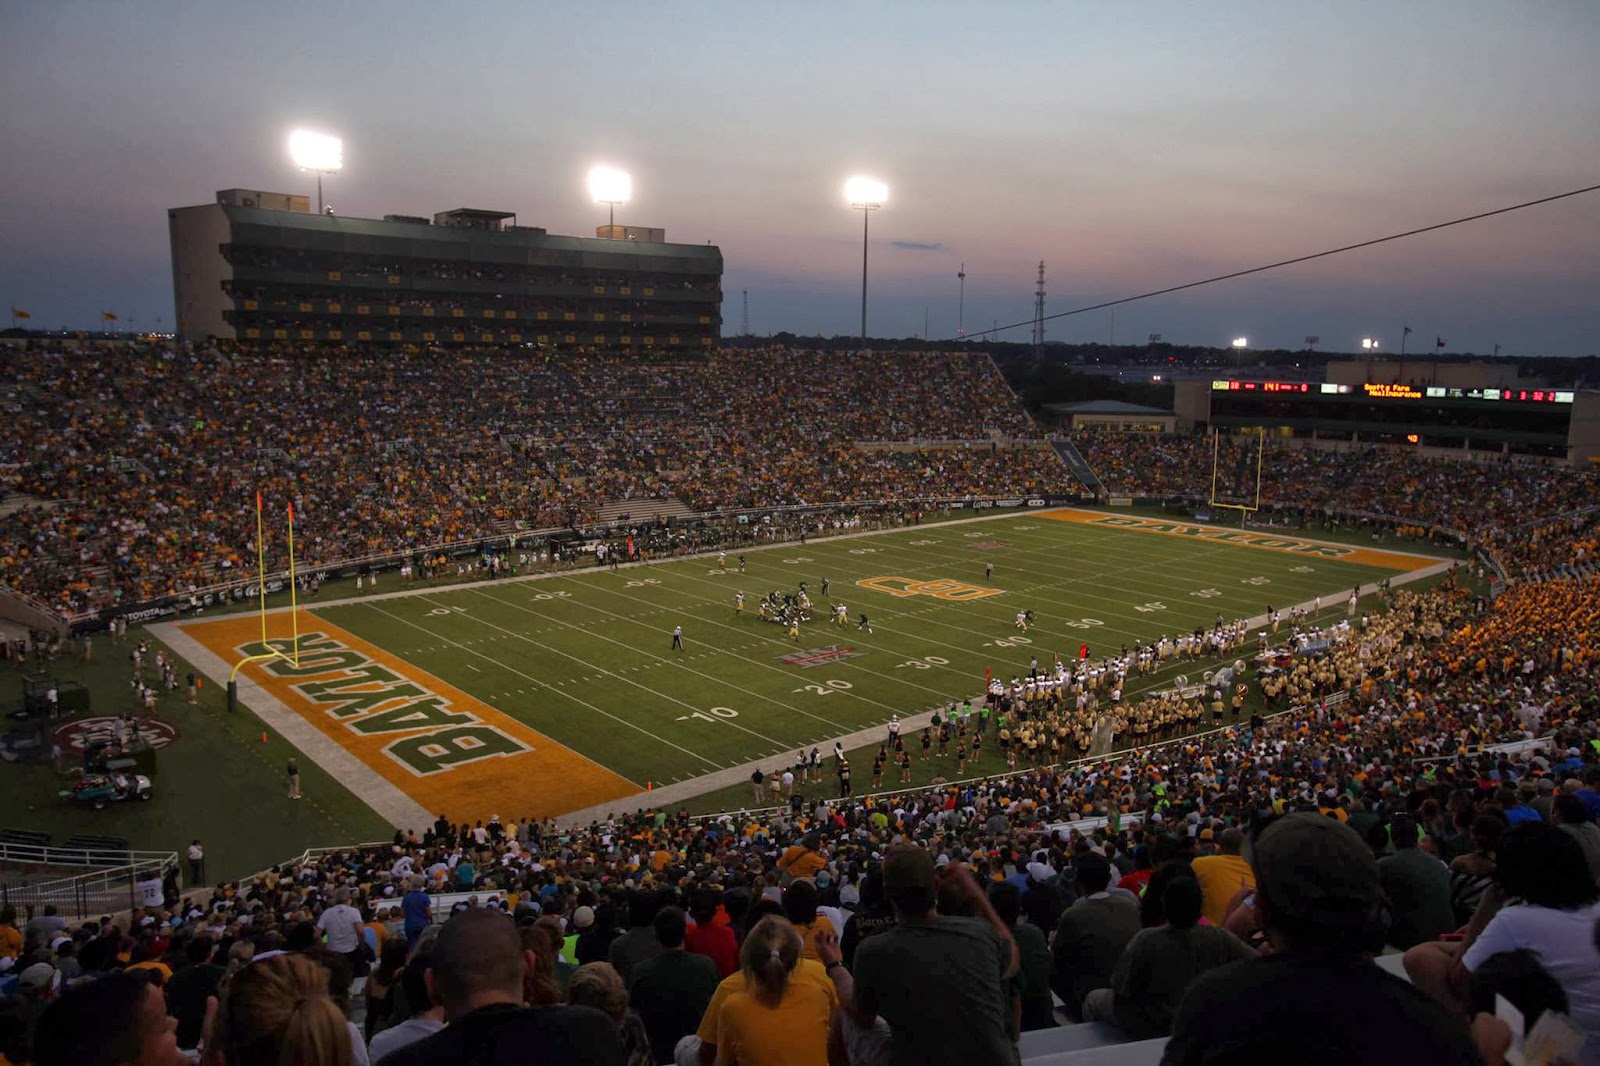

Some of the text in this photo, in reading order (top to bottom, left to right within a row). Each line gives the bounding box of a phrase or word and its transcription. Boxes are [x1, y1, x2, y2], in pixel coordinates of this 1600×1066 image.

[1089, 516, 1355, 557] BAYLOR
[128, 607, 160, 620] TOYOTA
[1066, 618, 1104, 629] 50
[994, 636, 1033, 648] 40
[905, 656, 949, 669] 30
[805, 679, 853, 695] 20
[233, 632, 535, 778] BAYLOR
[691, 706, 738, 723] 10
[143, 888, 155, 899] 72
